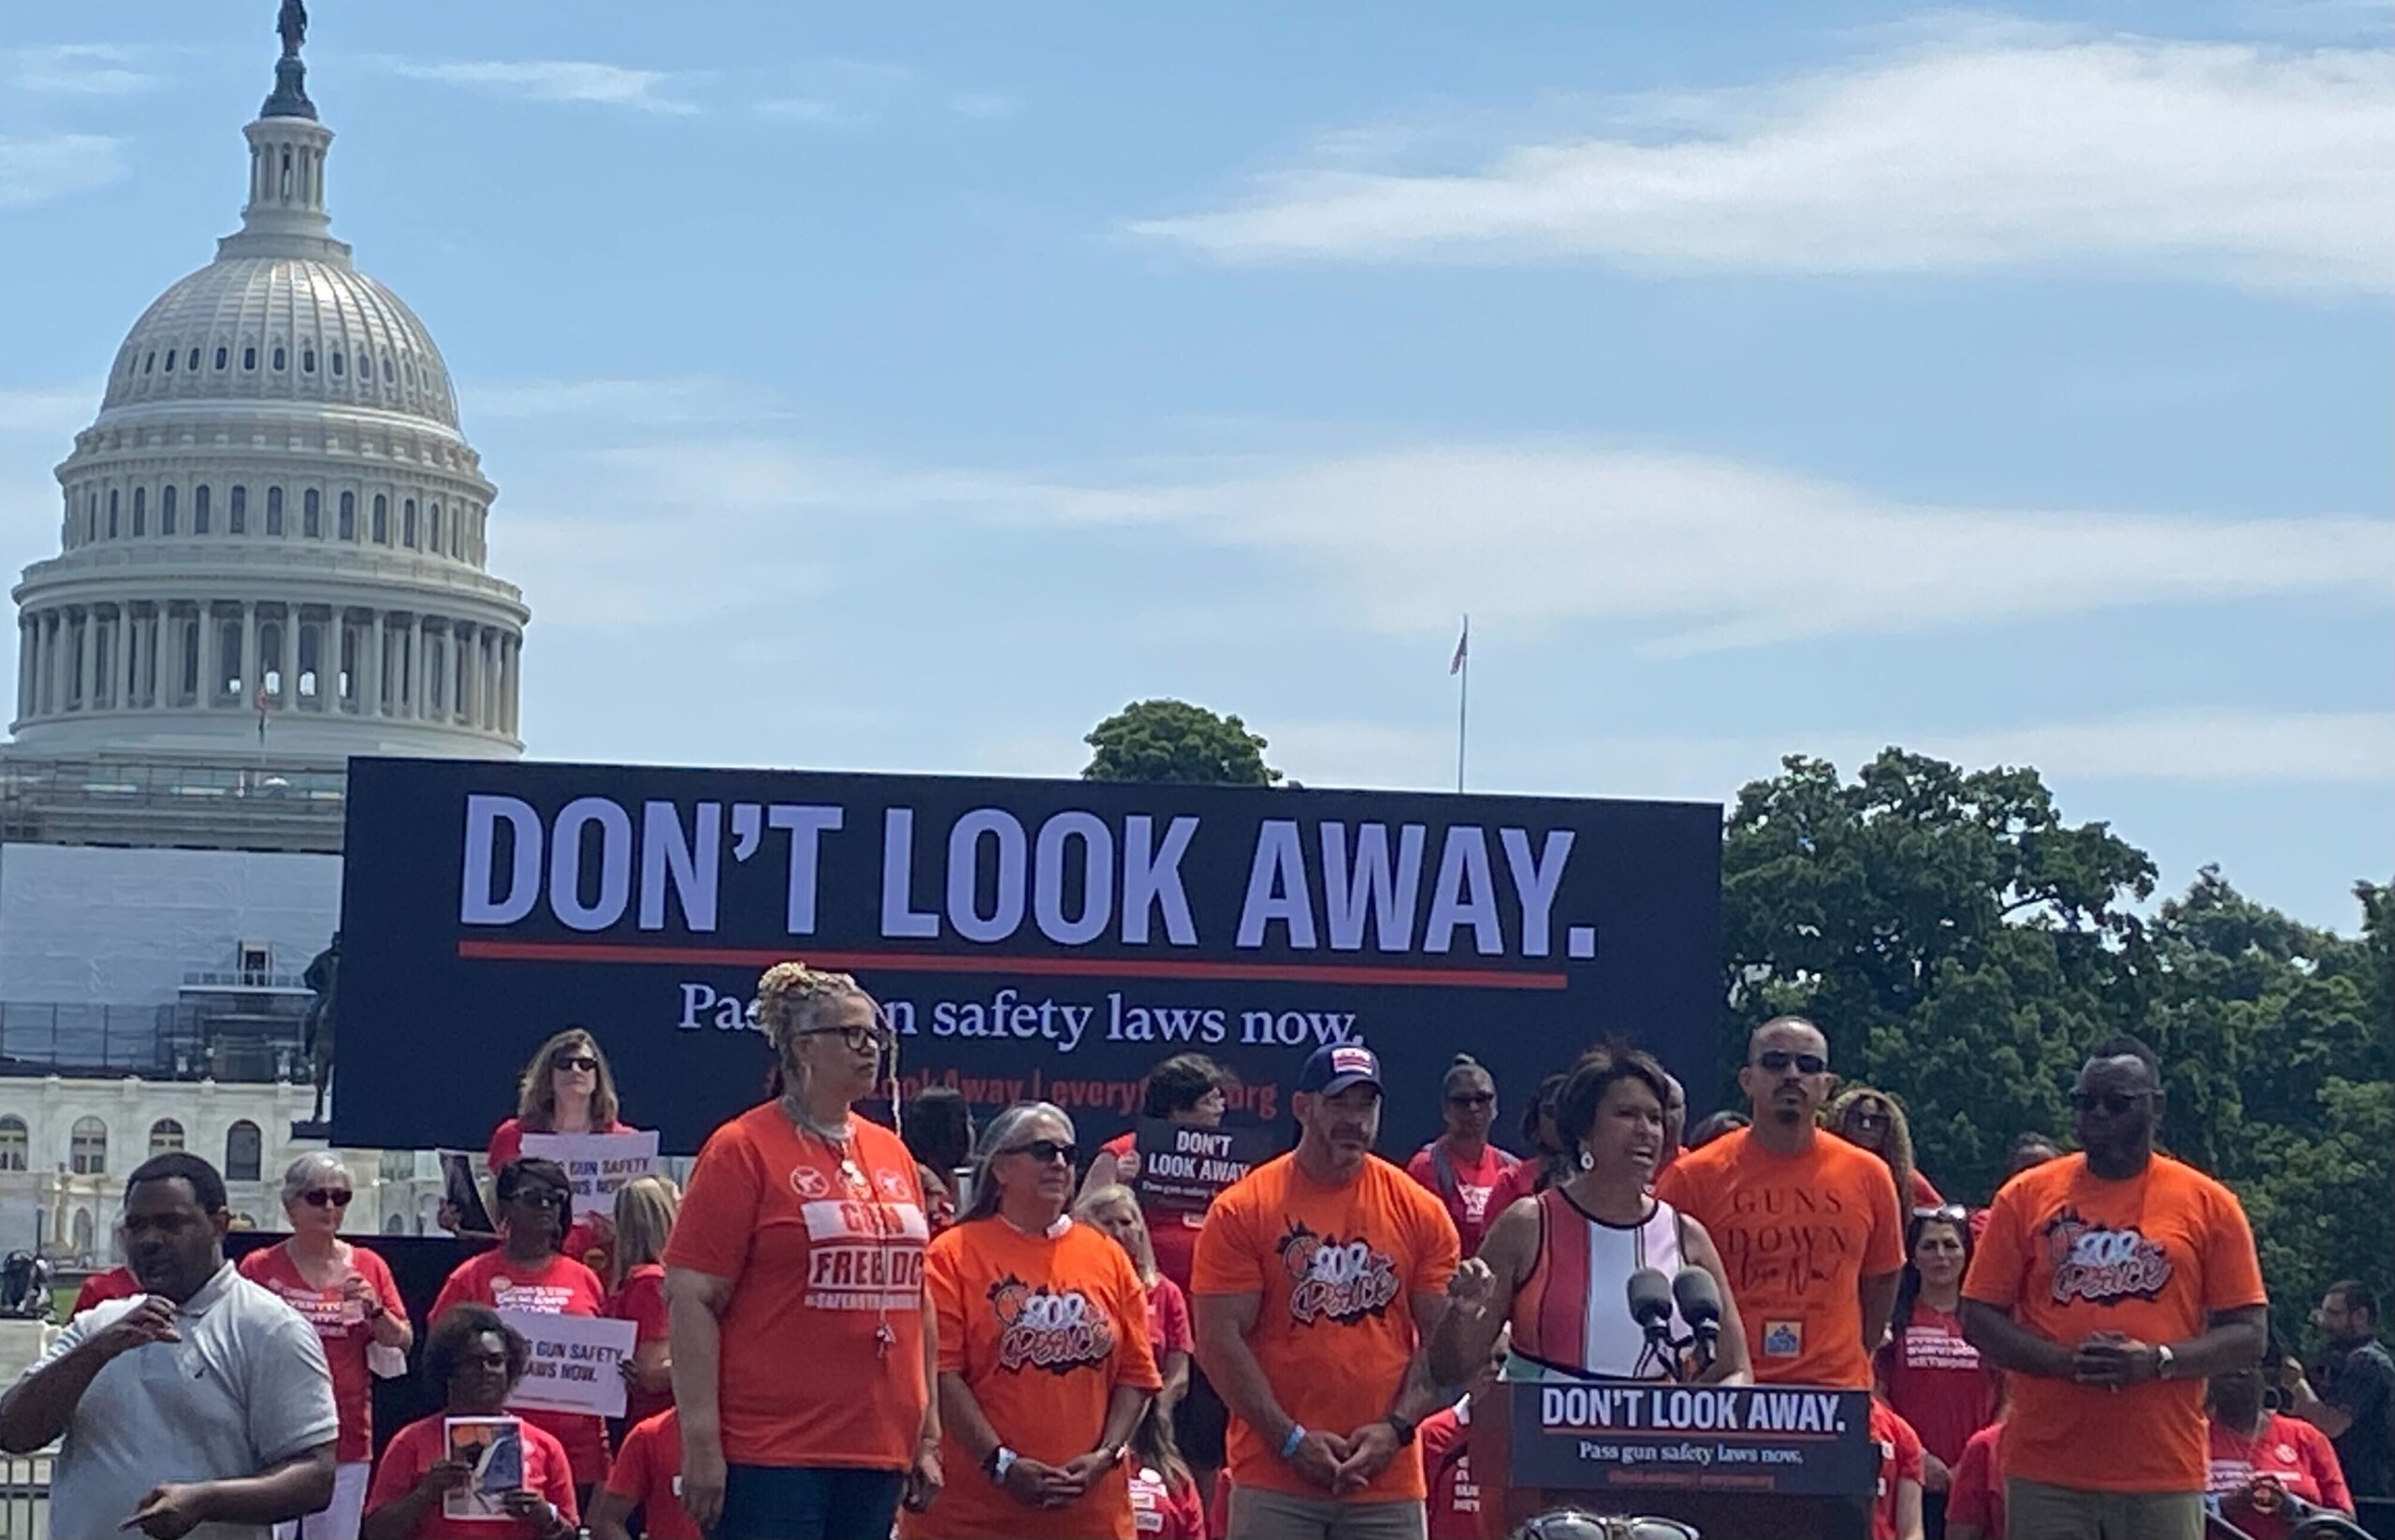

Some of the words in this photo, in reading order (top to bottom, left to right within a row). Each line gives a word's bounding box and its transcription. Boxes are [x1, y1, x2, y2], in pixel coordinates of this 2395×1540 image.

[460, 794, 843, 934] DON'T
[881, 807, 1199, 945] LOOK
[1236, 820, 1595, 958] AWAY.
[678, 983, 765, 1030] Pas
[933, 989, 1094, 1052] safety
[1107, 993, 1226, 1042] laws
[1241, 1012, 1364, 1045] now.
[1176, 1130, 1233, 1157] DON'T
[602, 1157, 650, 1174] SAFETY
[1148, 1153, 1197, 1178] LOOK
[1734, 1187, 1842, 1214] GUNS
[1726, 1225, 1851, 1255] DOWN
[812, 1250, 887, 1286] FREE
[536, 1341, 566, 1358] GUN
[570, 1342, 624, 1362] SAFETY
[526, 1360, 558, 1379] AWS
[1543, 1387, 1644, 1427] DON'T
[1652, 1390, 1738, 1430] LOOK
[1747, 1393, 1846, 1431] AWAY.
[1580, 1441, 1618, 1459] Pass
[1621, 1446, 1657, 1464] gun
[1661, 1444, 1712, 1466] safety
[1718, 1444, 1759, 1462] laws
